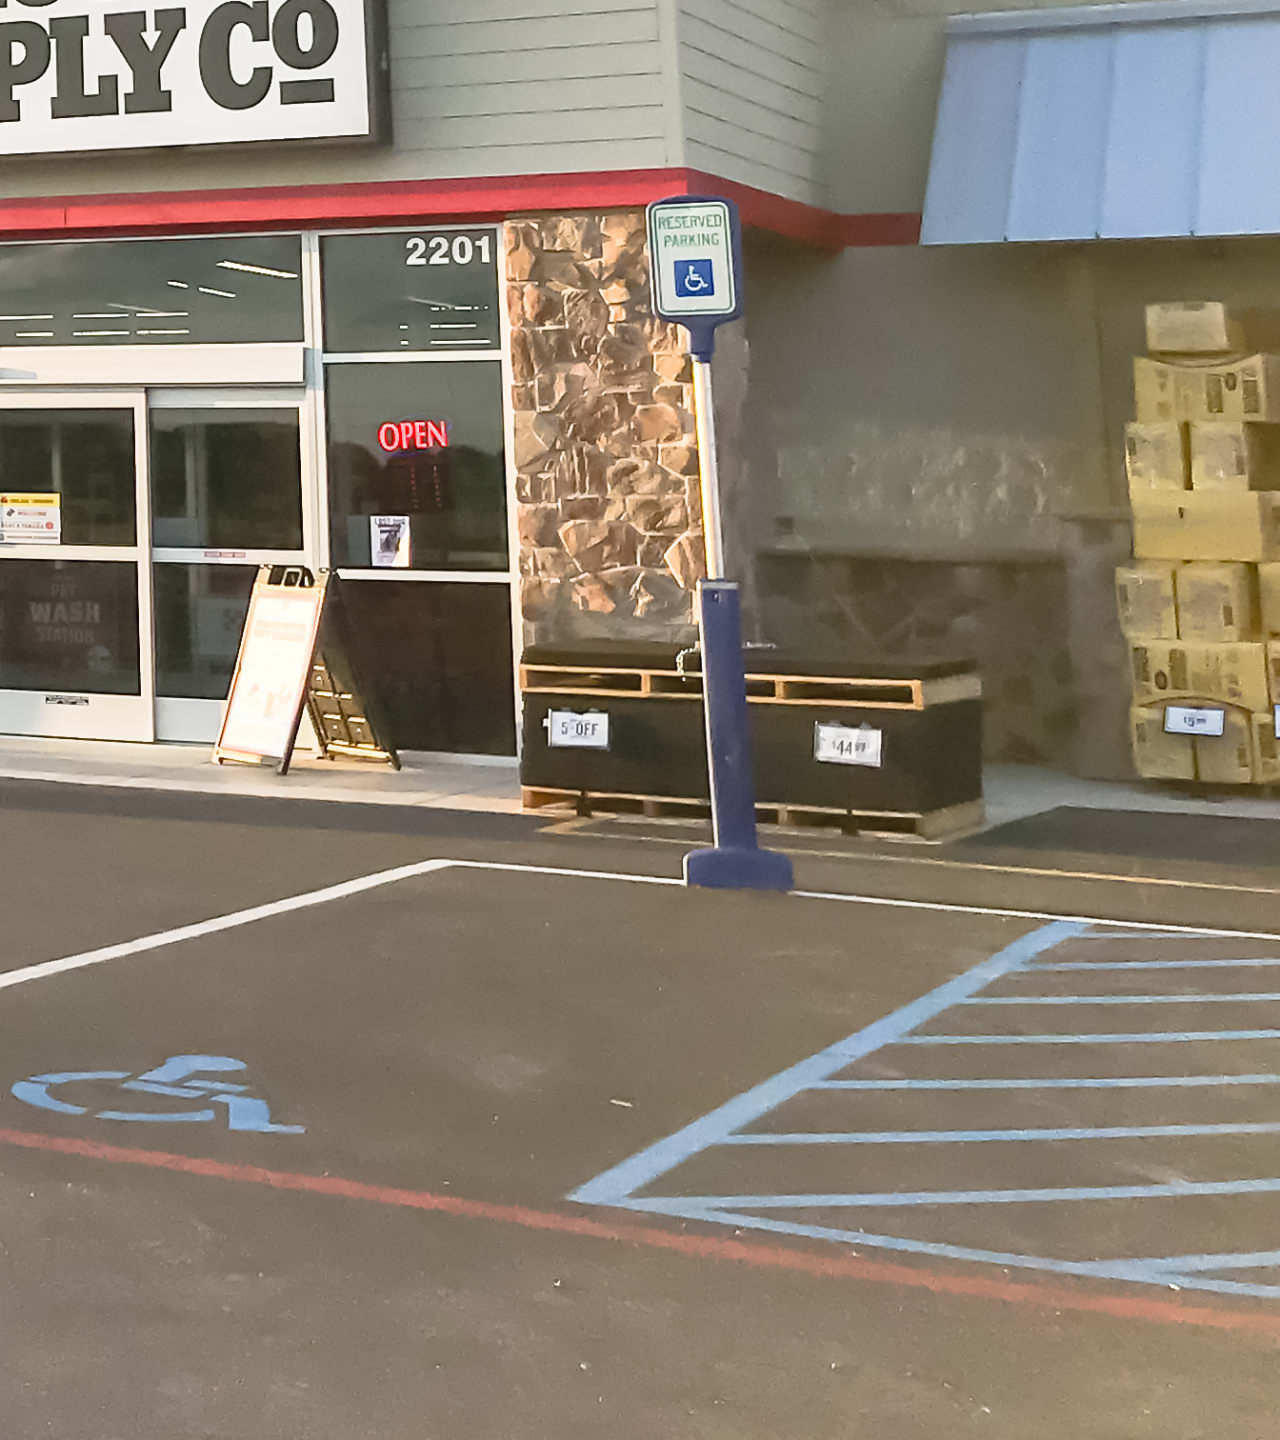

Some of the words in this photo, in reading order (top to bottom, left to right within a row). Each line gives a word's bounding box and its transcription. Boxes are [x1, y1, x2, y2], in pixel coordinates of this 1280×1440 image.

[658, 214, 722, 230] RESERVED
[663, 233, 720, 248] PARKING
[406, 235, 490, 266] 2201
[378, 420, 448, 452] OPEN
[30, 600, 101, 624] WASH
[35, 626, 95, 644] STATION
[576, 722, 599, 736] OFF
